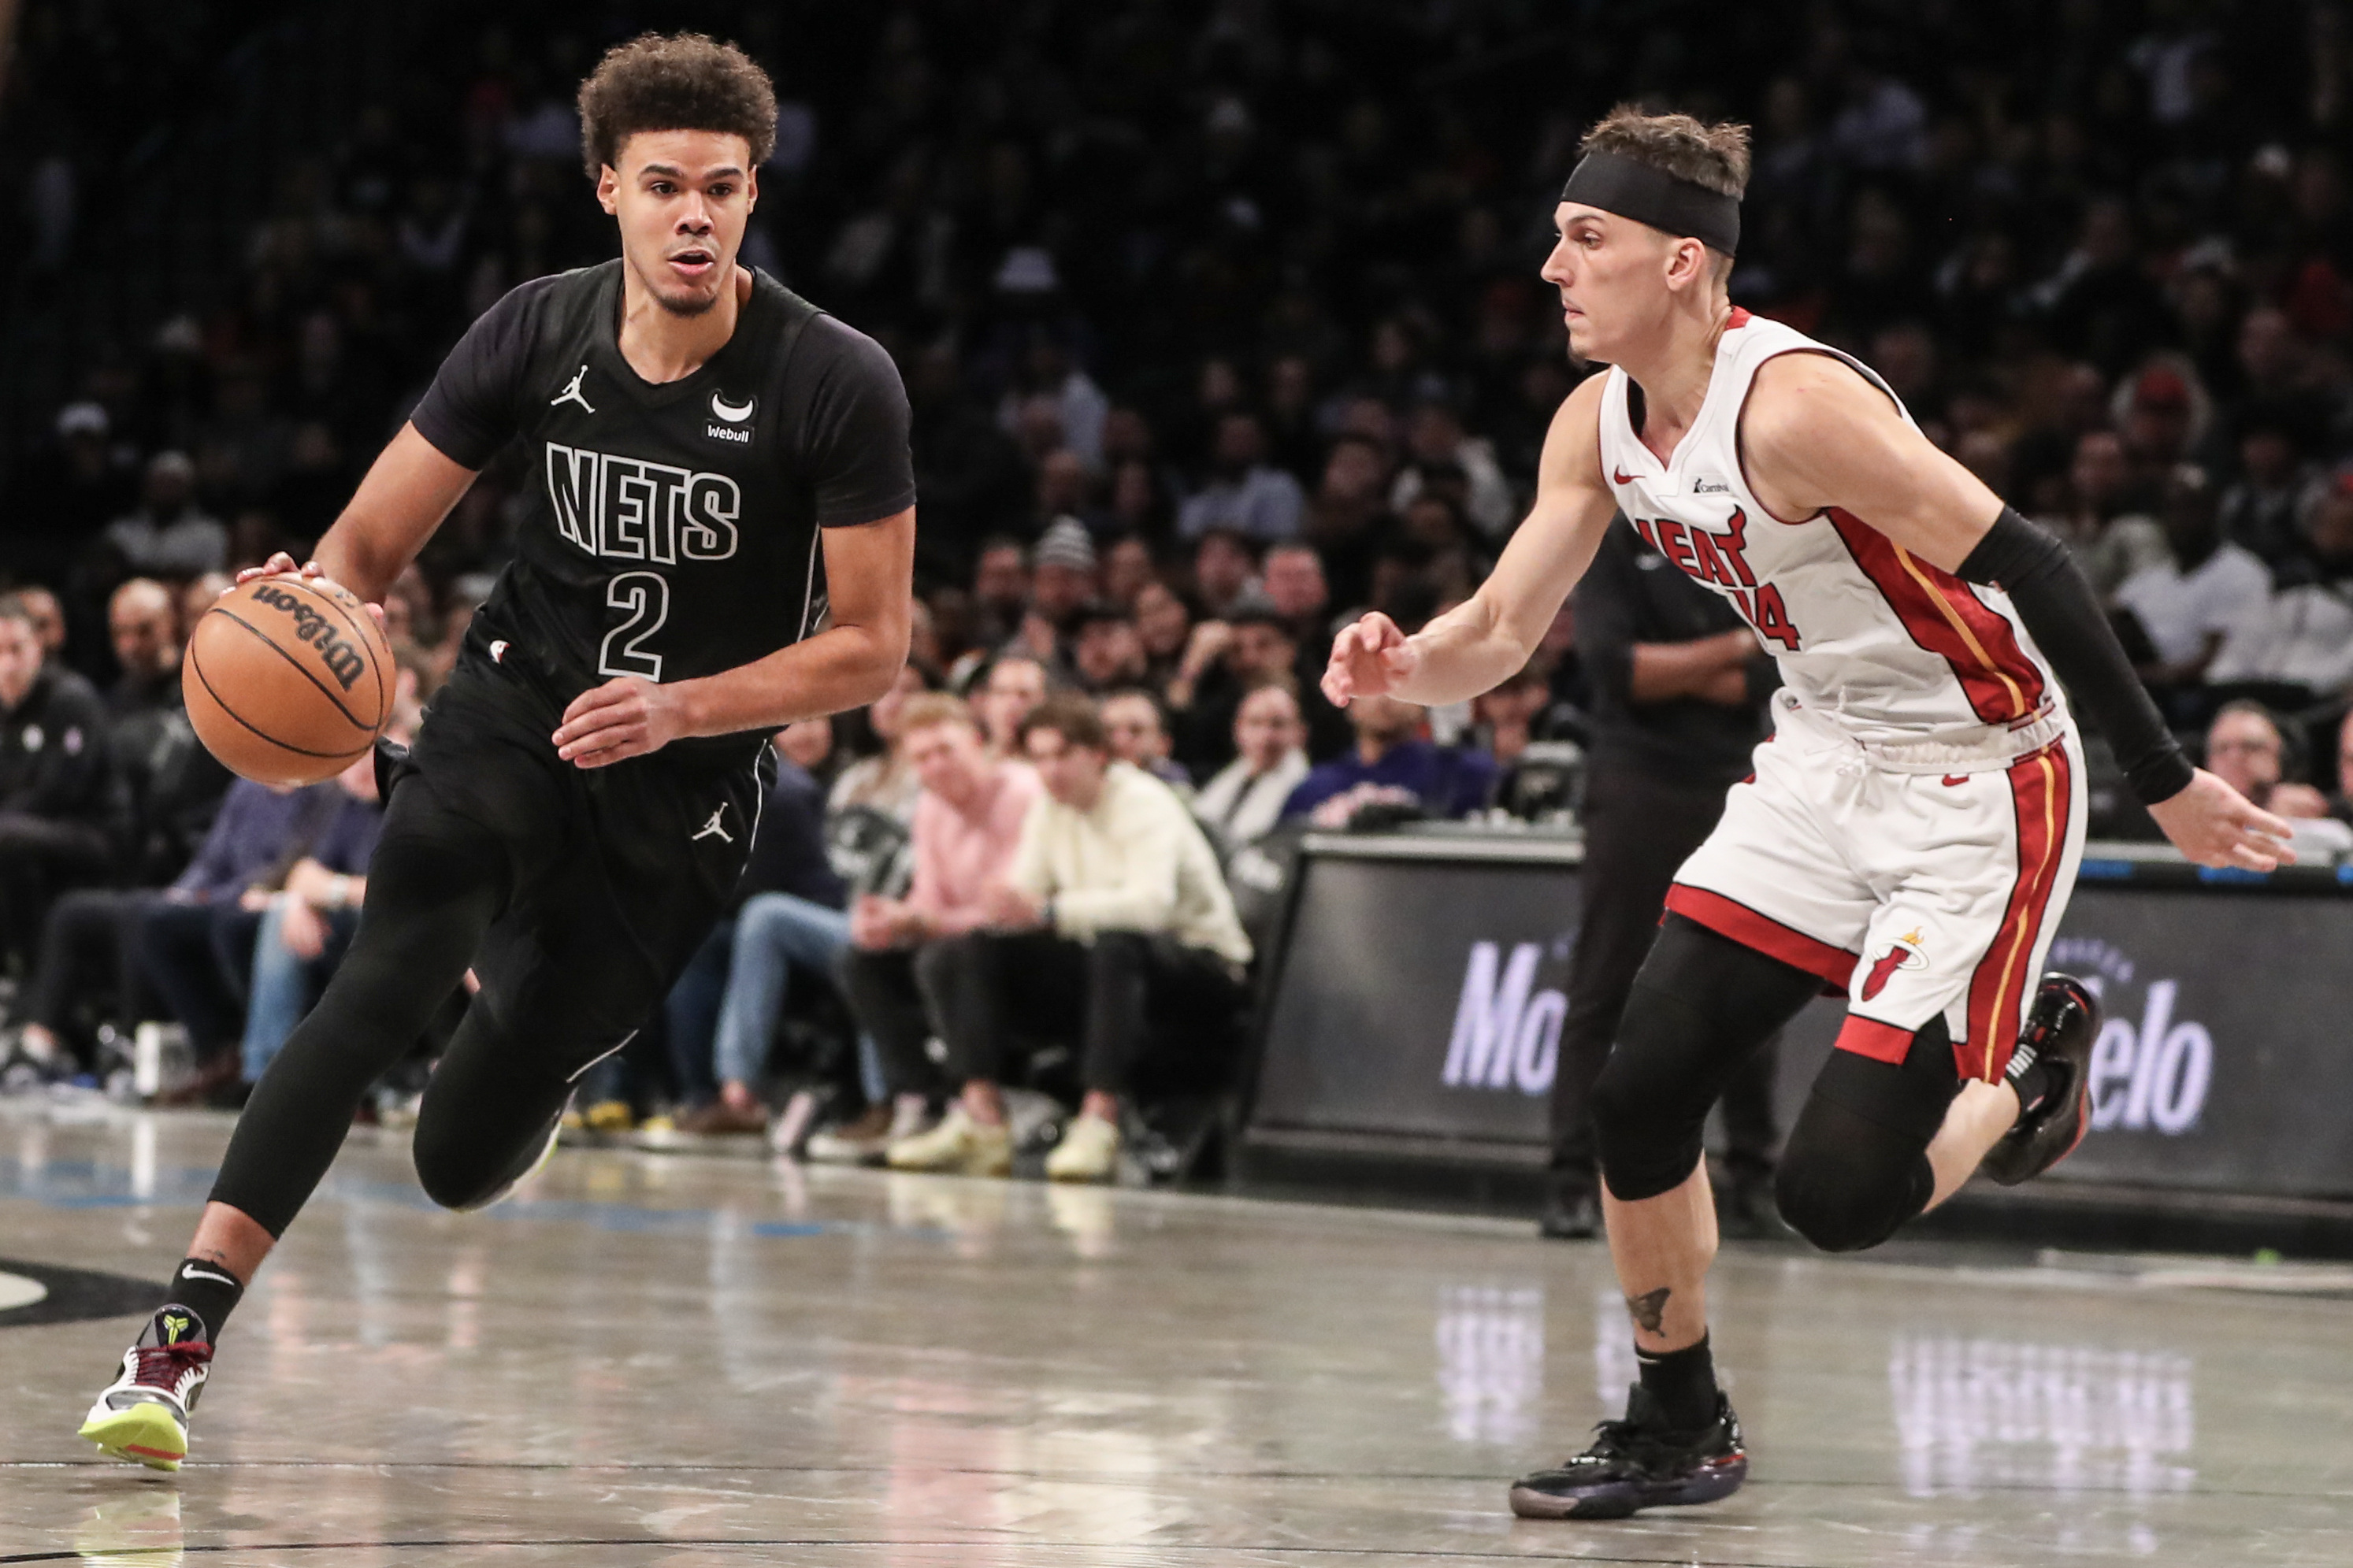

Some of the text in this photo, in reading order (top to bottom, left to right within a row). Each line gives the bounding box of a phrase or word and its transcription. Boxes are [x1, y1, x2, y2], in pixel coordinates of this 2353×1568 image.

[707, 424, 749, 443] Webull
[546, 441, 740, 565] NETS
[251, 584, 364, 692] Wilson
[598, 571, 670, 683] 2
[1442, 941, 1569, 1096] Mo
[2084, 977, 2214, 1136] elo
